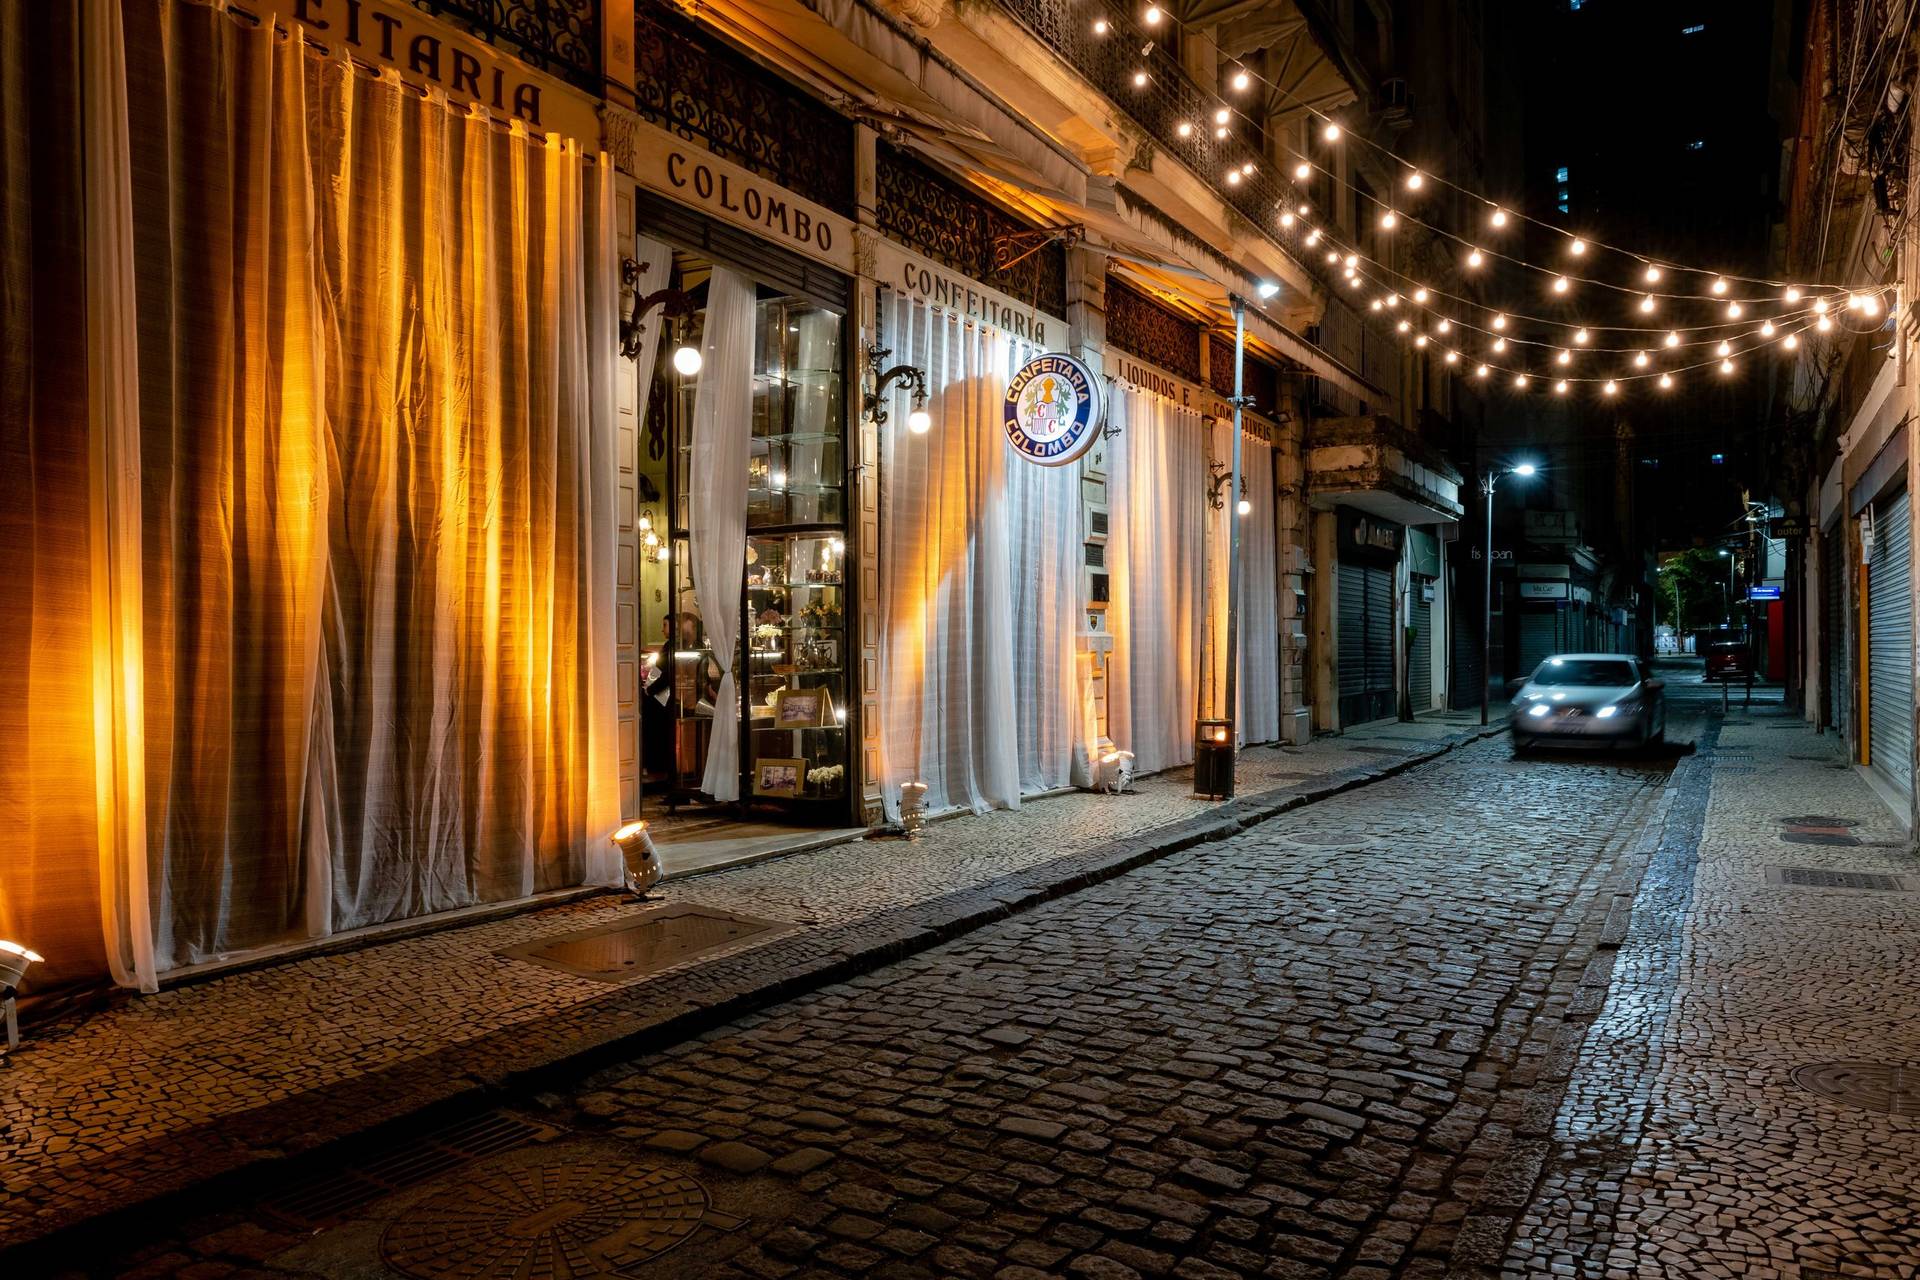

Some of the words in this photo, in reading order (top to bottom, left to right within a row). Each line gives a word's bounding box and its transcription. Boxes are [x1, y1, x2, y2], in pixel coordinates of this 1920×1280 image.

[667, 153, 832, 251] COLOMBO
[904, 262, 1046, 346] CONFEITARIA
[1006, 359, 1090, 404] CONFEITARIA
[1183, 387, 1190, 407] E
[1006, 418, 1085, 457] COLOMBO
